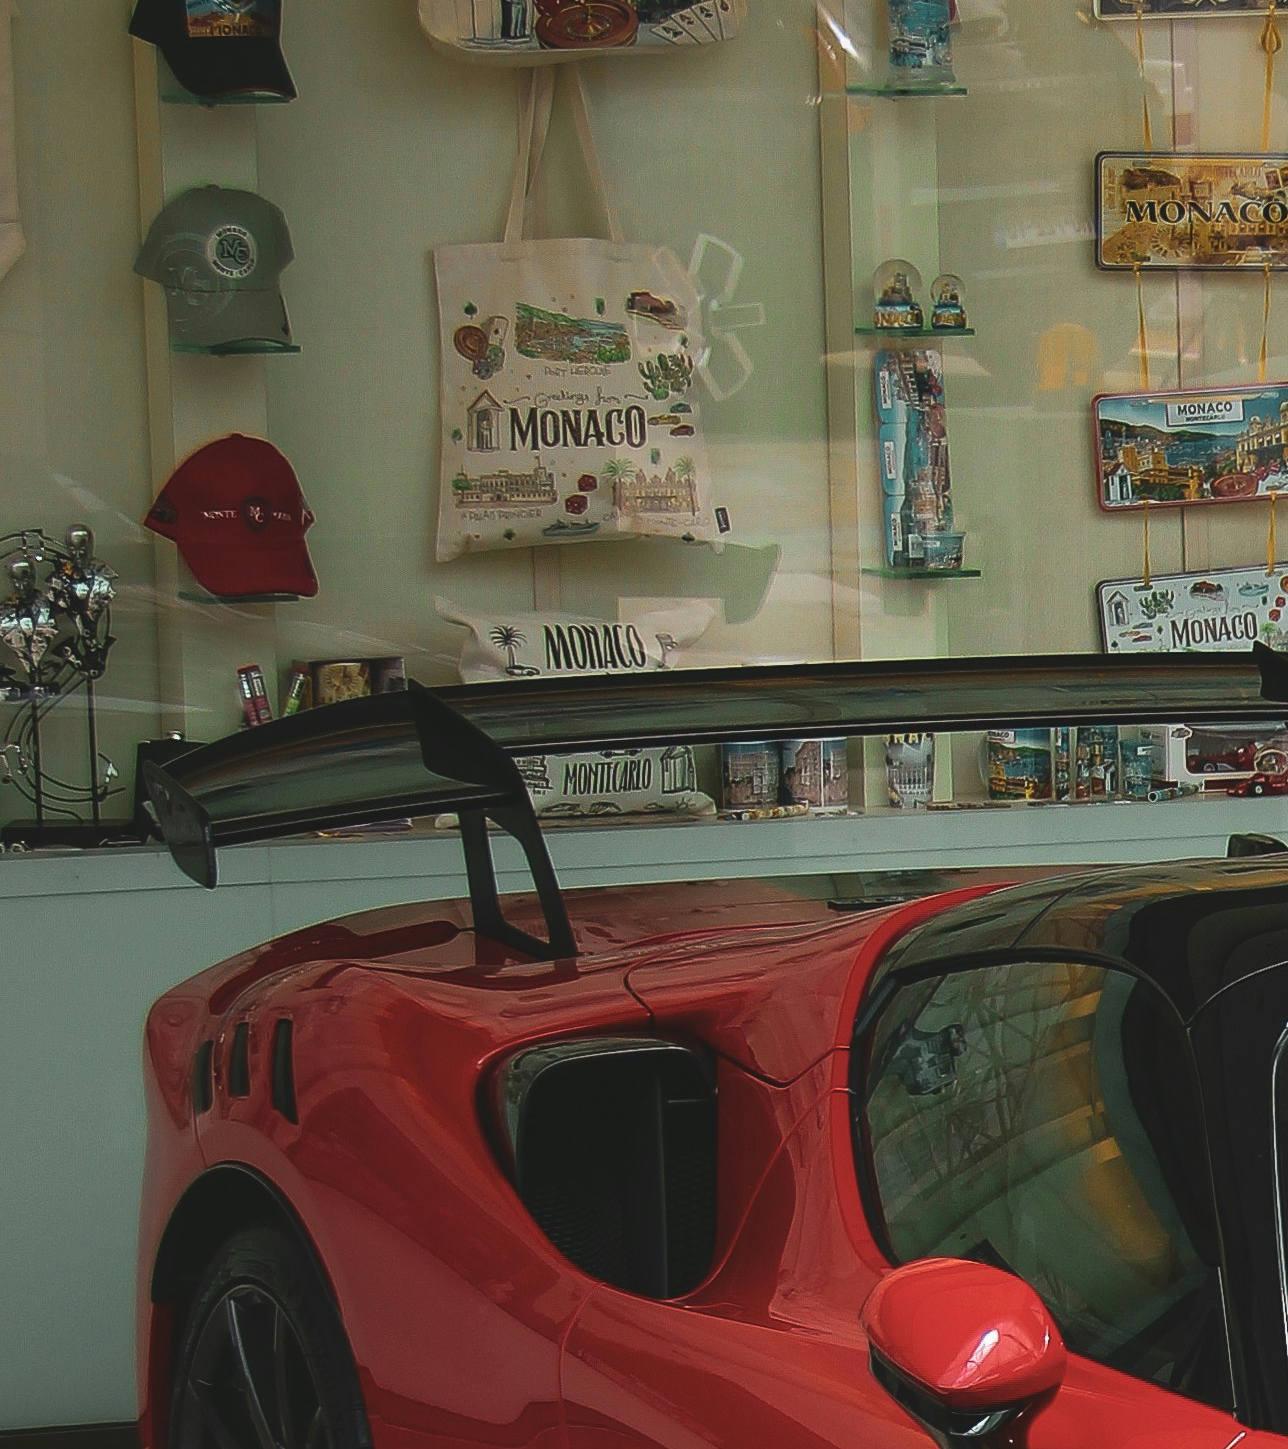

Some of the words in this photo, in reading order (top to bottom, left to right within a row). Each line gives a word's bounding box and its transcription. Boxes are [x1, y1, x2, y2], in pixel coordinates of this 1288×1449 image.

[1126, 200, 1288, 224] MONACO
[1177, 401, 1233, 416] MONACO
[510, 405, 647, 451] MONACO
[543, 624, 647, 669] MONACO
[1170, 612, 1258, 648] MONACO
[562, 757, 652, 796] MONTECARLO
